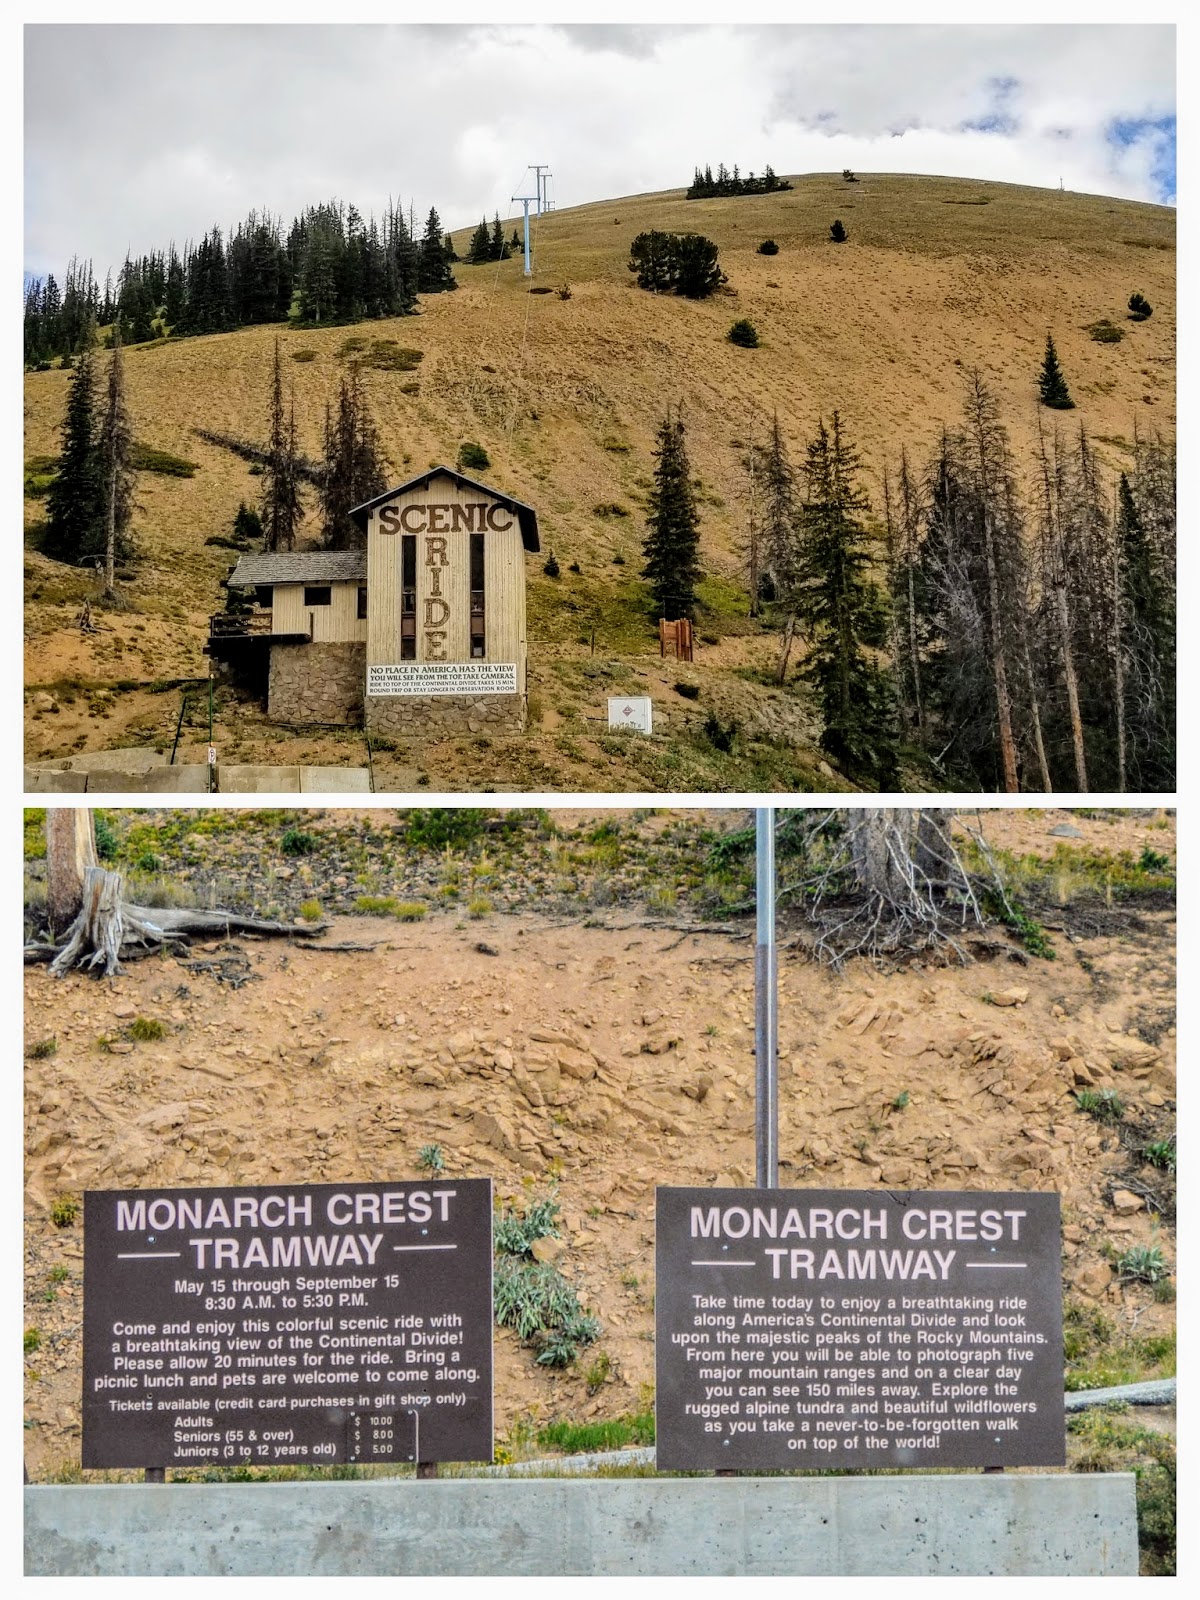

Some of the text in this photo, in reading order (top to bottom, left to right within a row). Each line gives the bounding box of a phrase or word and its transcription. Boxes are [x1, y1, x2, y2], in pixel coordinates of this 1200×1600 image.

[379, 503, 513, 535] SCENIC
[423, 537, 450, 661] RIDE
[385, 666, 408, 674] PLACE
[459, 665, 476, 673] HAS
[117, 1190, 456, 1230] MONARCH CREST
[691, 1207, 1027, 1240] MONARCH CREST
[189, 1234, 383, 1269] TRAMWAY
[764, 1248, 956, 1280] TRAMWAY
[174, 1274, 399, 1296] May 15 through September 15
[205, 1292, 368, 1310] 8:30 A.M. to 5:30 P.M.
[692, 1294, 1027, 1312] Take time today to enjoy a breathtaking ride
[112, 1313, 462, 1336] Come and enjoy this colorful scenic ride with
[693, 1313, 1026, 1329] along America's Continental Divide and look
[126, 1331, 463, 1354] breathtaking view of the Continental Divide!
[671, 1330, 1048, 1347] upon the majestic peaks of the Rocky Mountains.
[114, 1349, 445, 1370] Please allow 20 minutes for the ride. Bring
[686, 1347, 1034, 1364] From here you will be able to photograph five
[94, 1367, 480, 1391] picnic lunch and pets are welcome to come along.
[699, 1365, 1022, 1382] major mountain ranges and on a clear day
[705, 1382, 1018, 1400] you can see 150 miles away. Explore the
[157, 1398, 210, 1410] available
[214, 1397, 253, 1412] (credit
[258, 1396, 287, 1408] card
[290, 1396, 354, 1410] purchases
[358, 1394, 370, 1406] in
[374, 1394, 395, 1408] gift
[400, 1393, 431, 1407] shop
[435, 1392, 466, 1406] only)
[685, 1399, 1037, 1418] rugged alpine tundra and beautiful wildflowers
[174, 1416, 393, 1427] Adults 10.00
[704, 1417, 1019, 1435] as you take a never-to-be-forgotten walk
[173, 1429, 394, 1444] Seniors (55 over) 8.00
[787, 1435, 940, 1452] on top of the world!
[173, 1443, 393, 1458] Juniors (3 to 12 years old) 5.00
